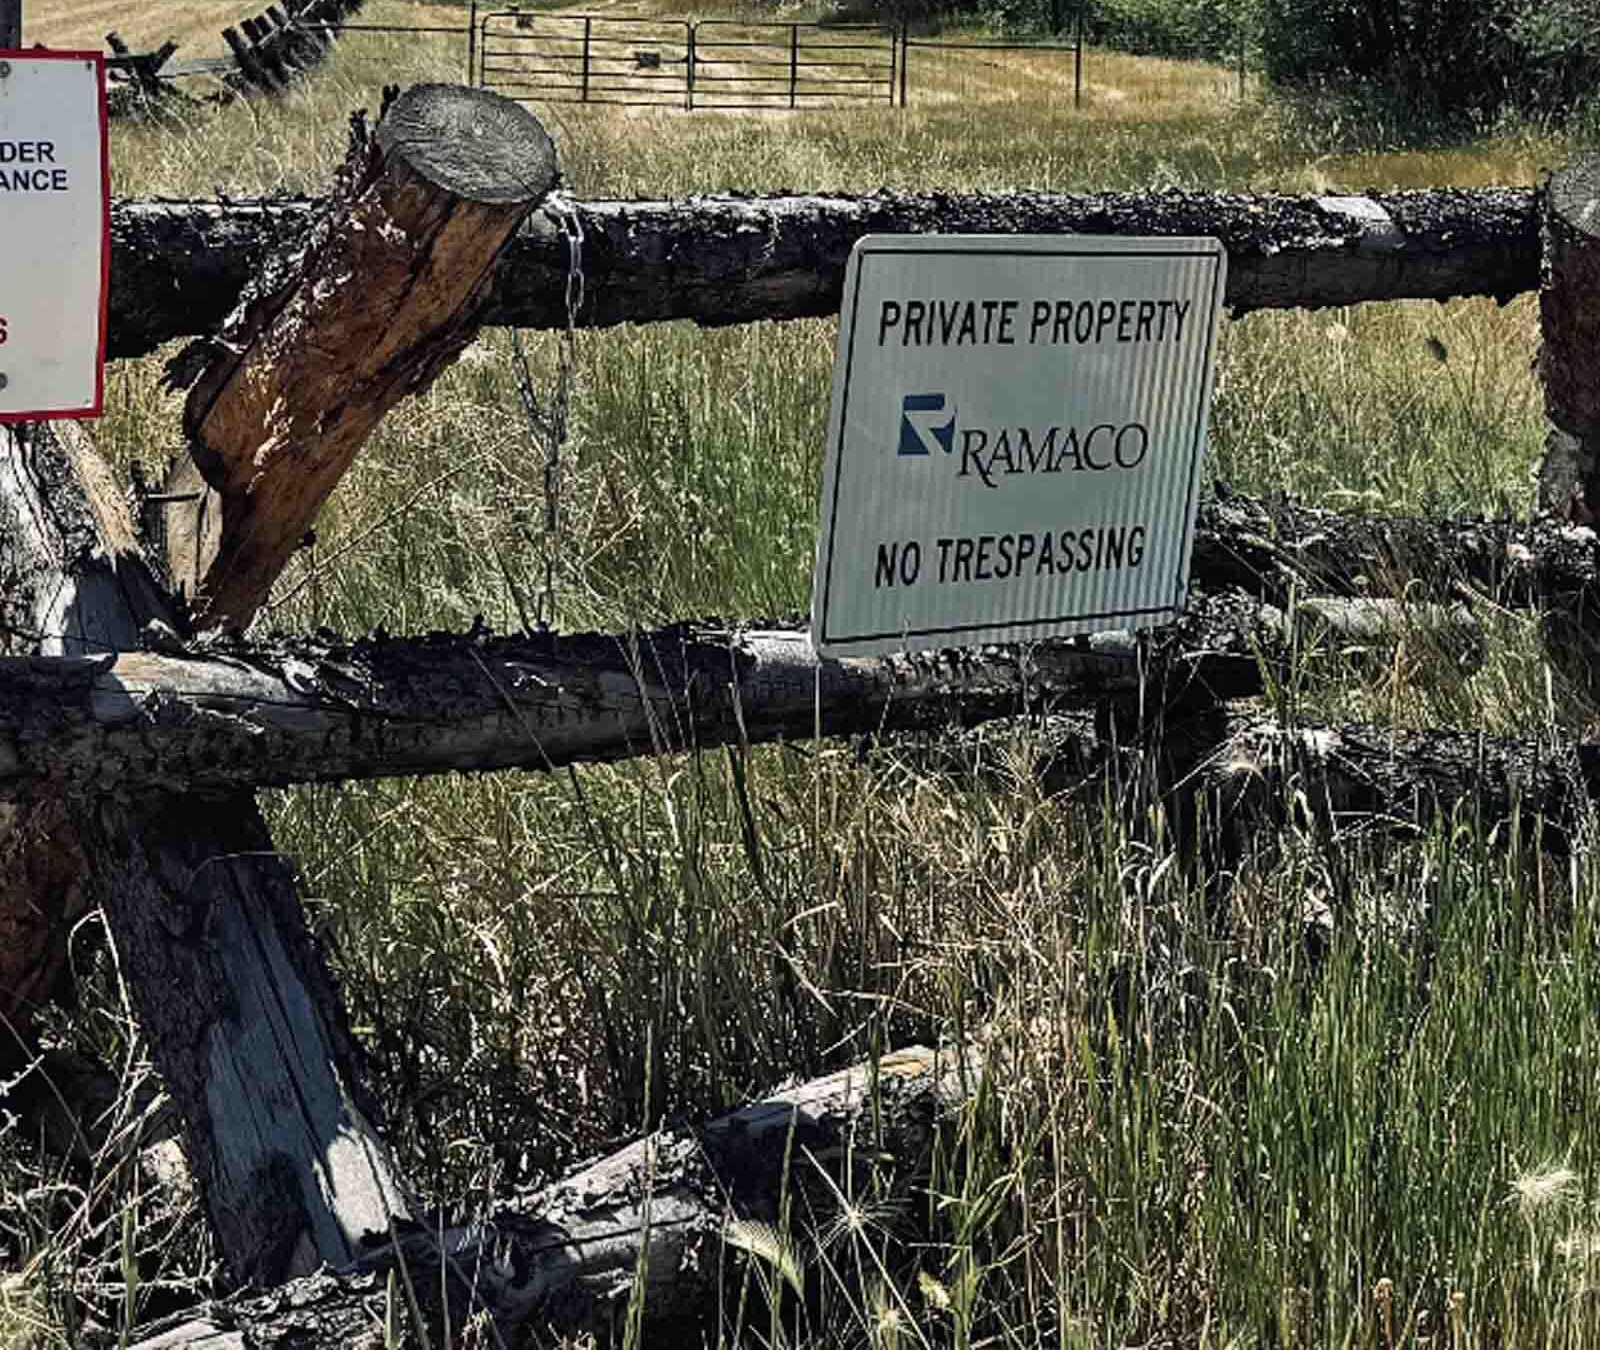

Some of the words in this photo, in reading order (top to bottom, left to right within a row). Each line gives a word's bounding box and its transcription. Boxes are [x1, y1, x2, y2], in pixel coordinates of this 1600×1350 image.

[877, 300, 1019, 347] PRIVATE
[1028, 299, 1192, 345] PROPERTY
[956, 422, 1150, 488] RAMACO
[874, 542, 921, 588] NO
[936, 526, 1146, 583] TRESPASSING
